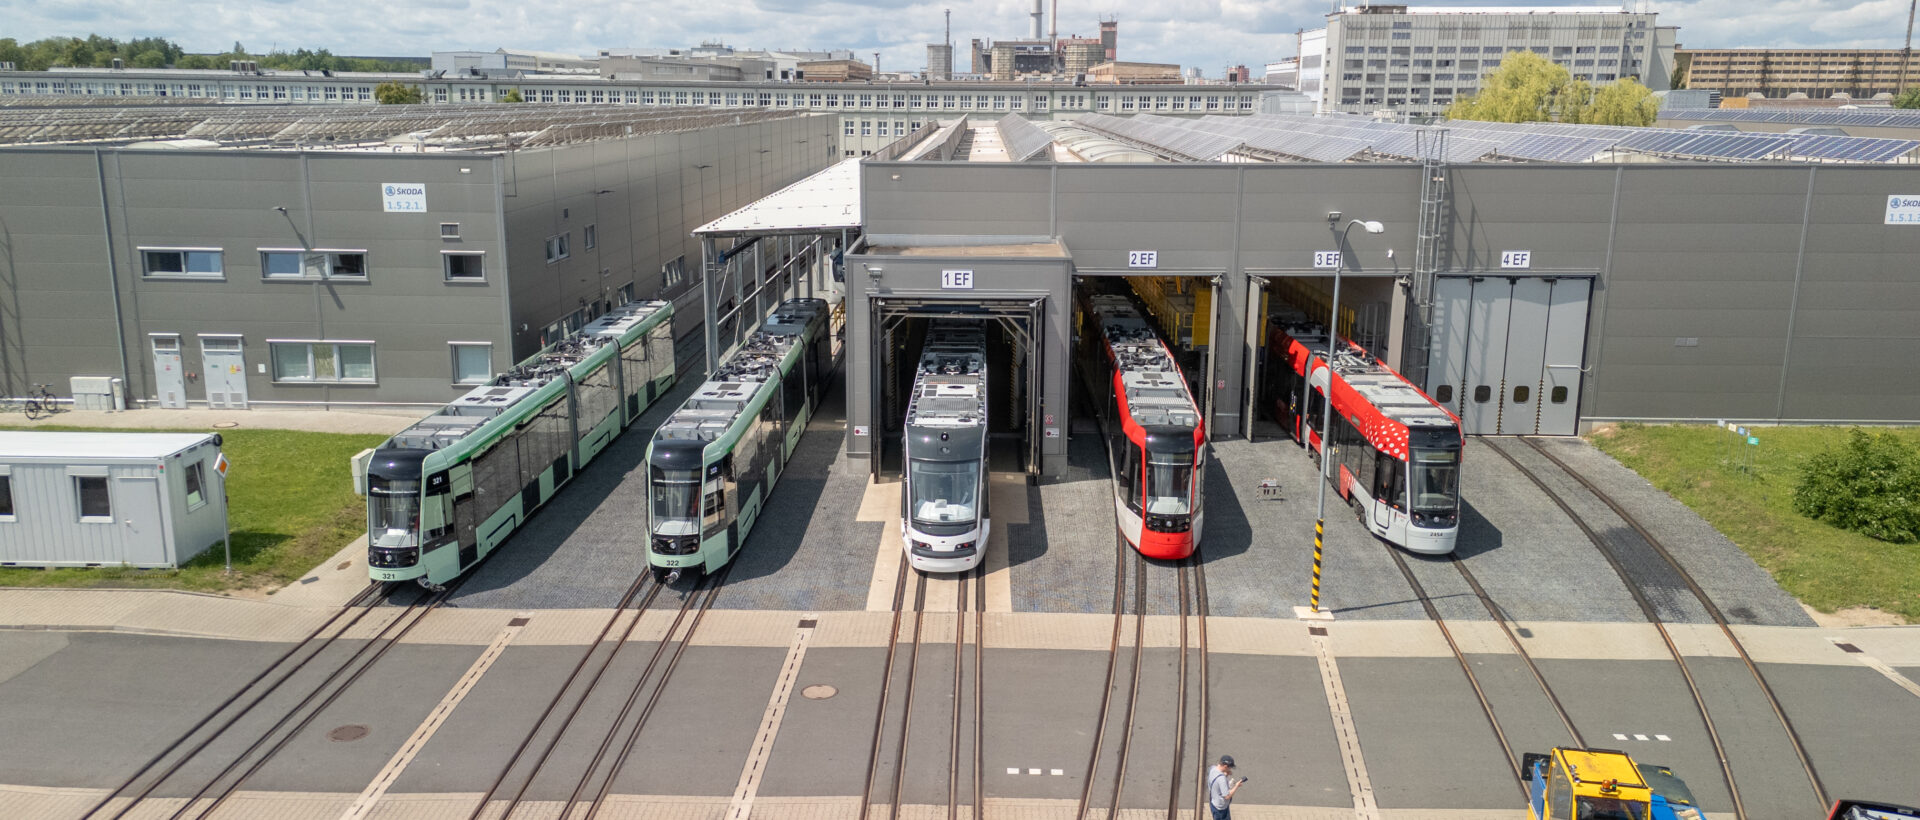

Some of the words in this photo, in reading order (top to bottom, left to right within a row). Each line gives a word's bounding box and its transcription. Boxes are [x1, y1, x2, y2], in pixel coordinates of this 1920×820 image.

[396, 187, 423, 195] ŠKODA
[1131, 253, 1137, 264] 2
[1140, 253, 1154, 264] EF
[1316, 253, 1322, 265] 3
[1326, 253, 1340, 265] EF
[1503, 253, 1509, 265] 4
[1513, 253, 1527, 265] EF
[944, 272, 949, 286] 1
[954, 272, 969, 286] EF
[432, 476, 442, 485] 321
